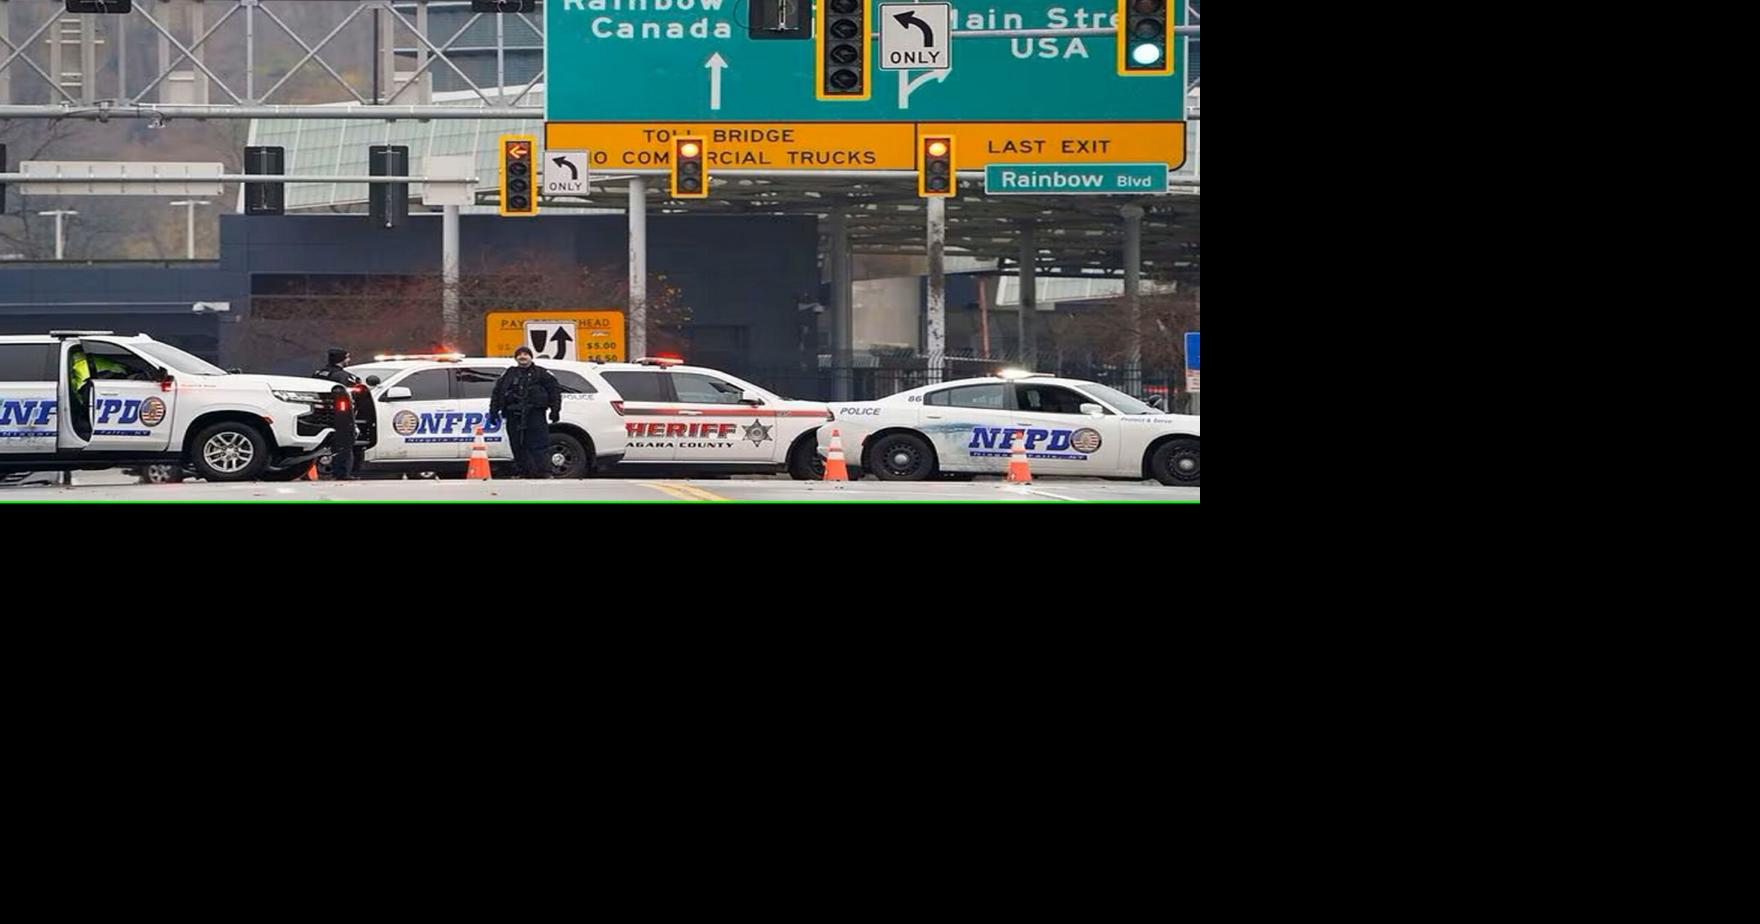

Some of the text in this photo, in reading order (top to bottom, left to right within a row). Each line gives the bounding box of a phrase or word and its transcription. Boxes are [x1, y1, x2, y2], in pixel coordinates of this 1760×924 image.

[591, 17, 731, 39] Canada
[1011, 37, 1089, 59] USA
[890, 51, 940, 64] ONLY
[713, 129, 795, 143] BRIDGE
[988, 140, 1111, 154] LAST EXIT
[787, 151, 876, 165] TRUCKS
[1002, 171, 1152, 188] Rainbow Blvd
[549, 182, 583, 192] ONLY
[586, 342, 617, 350] $5.00
[840, 407, 882, 416] POLICE
[968, 427, 1072, 451] NFPD
